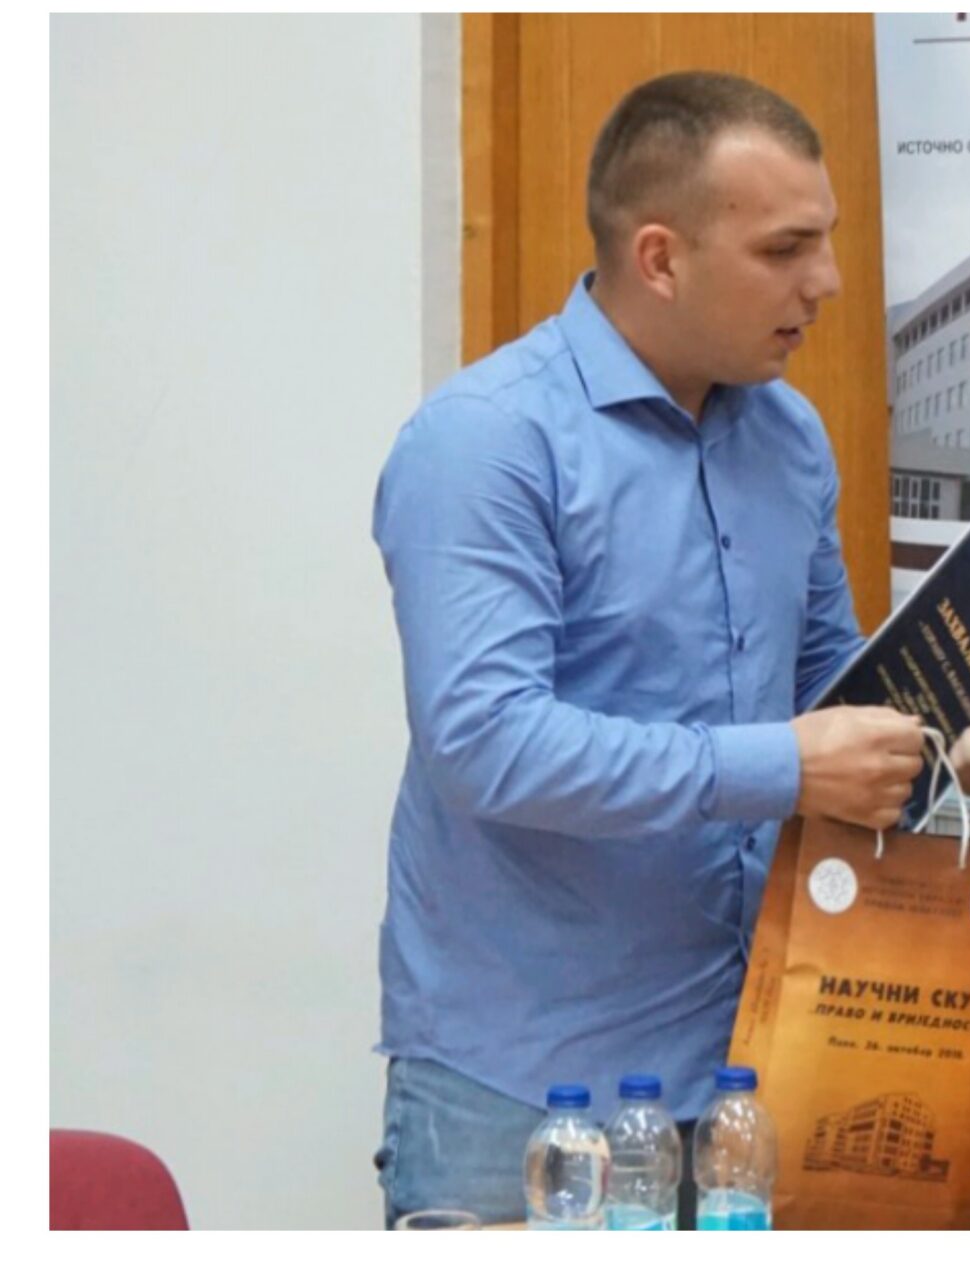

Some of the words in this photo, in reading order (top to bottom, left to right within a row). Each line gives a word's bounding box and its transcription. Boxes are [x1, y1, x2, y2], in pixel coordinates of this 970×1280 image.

[897, 140, 963, 155] ИСТОЧНО
[819, 975, 920, 1005] НАУЧНИ
[871, 1010, 883, 1021] И
